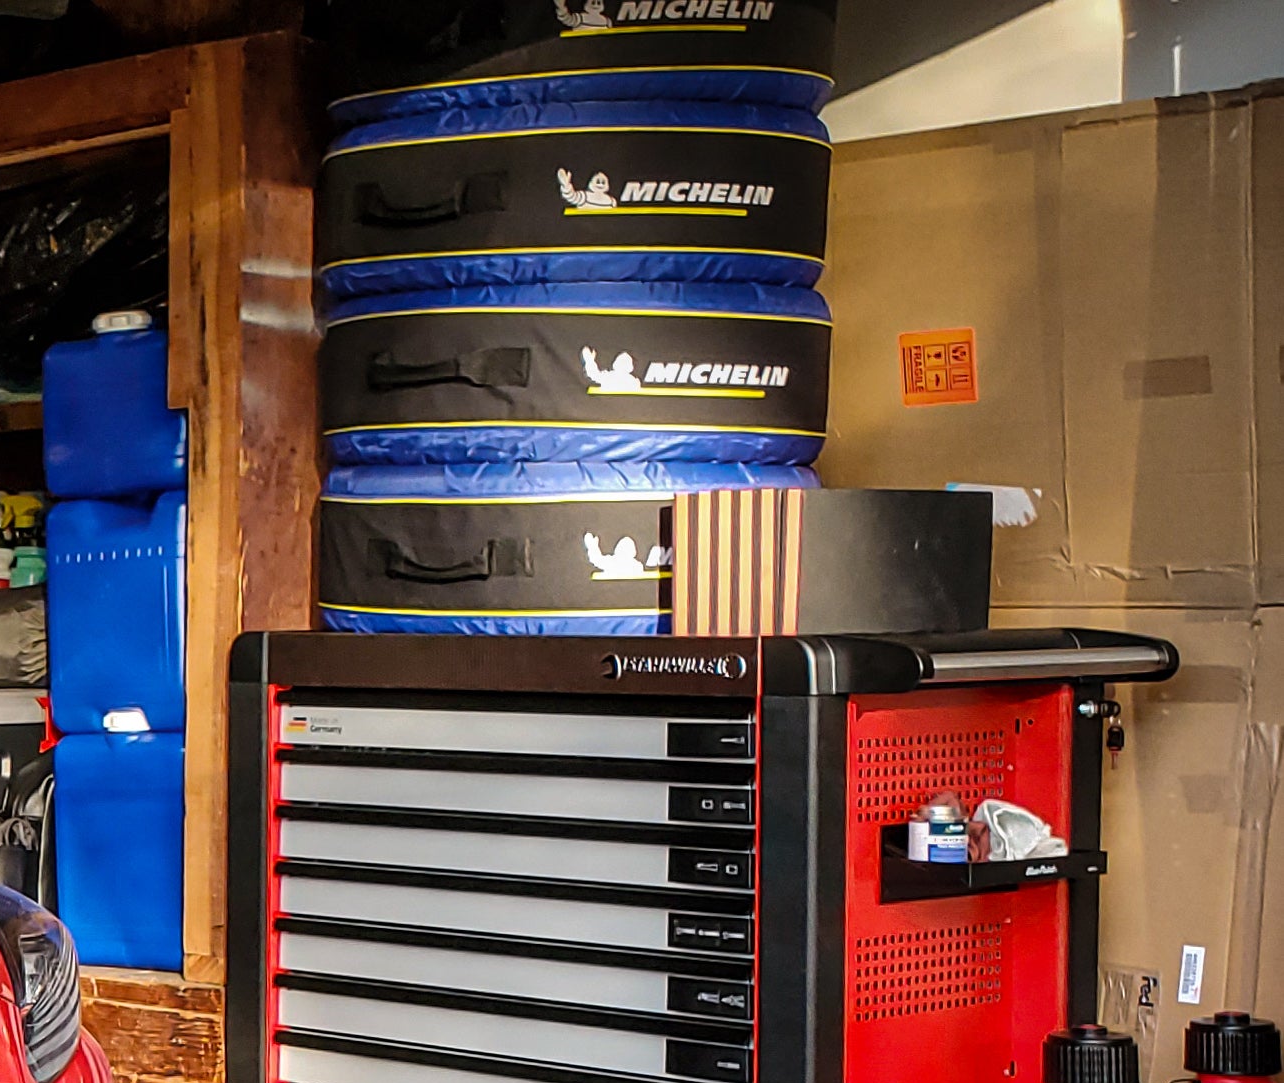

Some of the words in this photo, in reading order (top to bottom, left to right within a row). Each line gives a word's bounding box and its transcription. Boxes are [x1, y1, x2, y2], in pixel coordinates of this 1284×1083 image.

[616, 0, 774, 21] MICHELIN
[620, 181, 774, 206] MICHELIN
[644, 362, 790, 387] MICHELIN
[913, 345, 925, 393] FRAGILE
[310, 725, 343, 735] Germany
